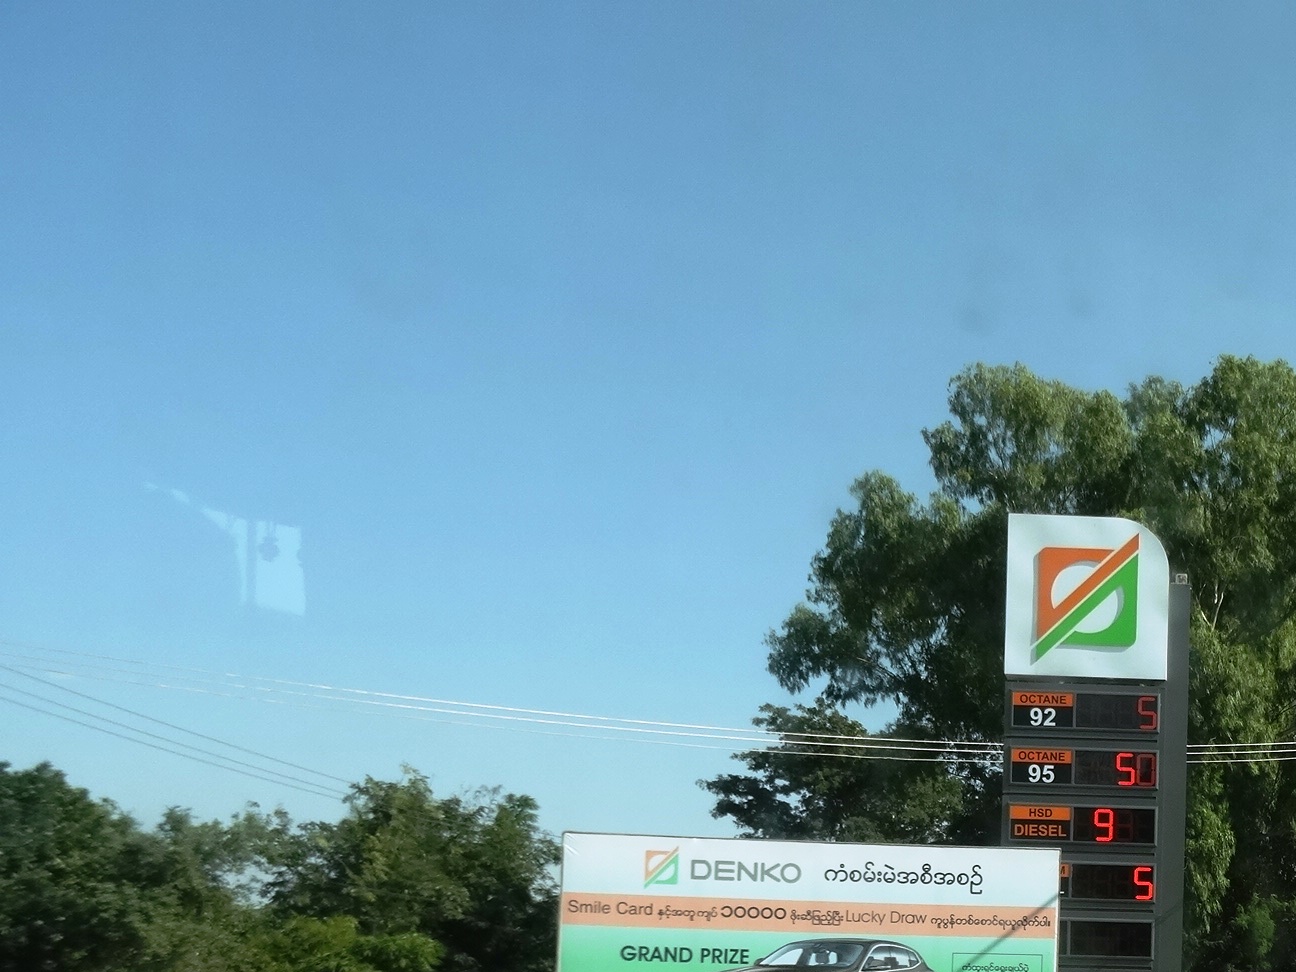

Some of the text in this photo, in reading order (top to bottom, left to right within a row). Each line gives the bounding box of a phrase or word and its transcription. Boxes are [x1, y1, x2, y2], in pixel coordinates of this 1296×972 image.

[1019, 694, 1067, 705] OCTANE
[1029, 707, 1057, 727] 92
[1137, 696, 1157, 730] 5
[1018, 751, 1066, 761] OCTANE
[1028, 764, 1055, 783] 95
[1028, 808, 1053, 818] HSD
[1014, 824, 1067, 837] DIESEL
[690, 859, 802, 884] DENKO
[1133, 866, 1154, 900] 5
[567, 899, 611, 915] Smile
[616, 901, 654, 916] Card
[846, 909, 886, 926] Lucky
[890, 911, 928, 924] Draw
[620, 945, 750, 965] GRAND PRIZE
